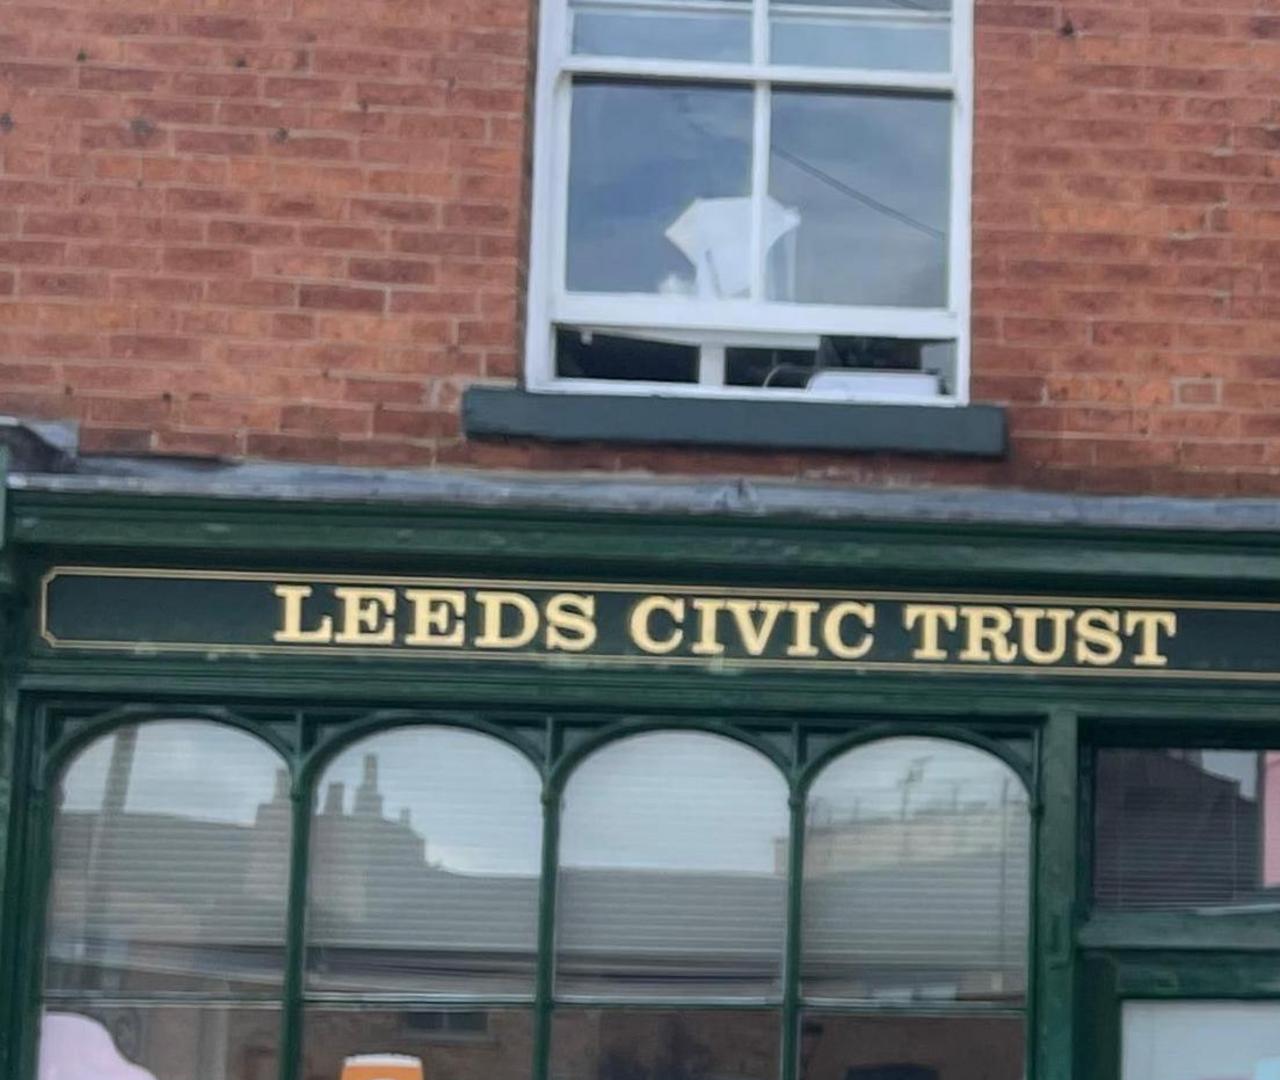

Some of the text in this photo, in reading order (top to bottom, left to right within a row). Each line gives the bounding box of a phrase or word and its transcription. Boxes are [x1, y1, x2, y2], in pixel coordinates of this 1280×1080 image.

[274, 584, 1177, 668] LEEDS CIVIC TRUST
